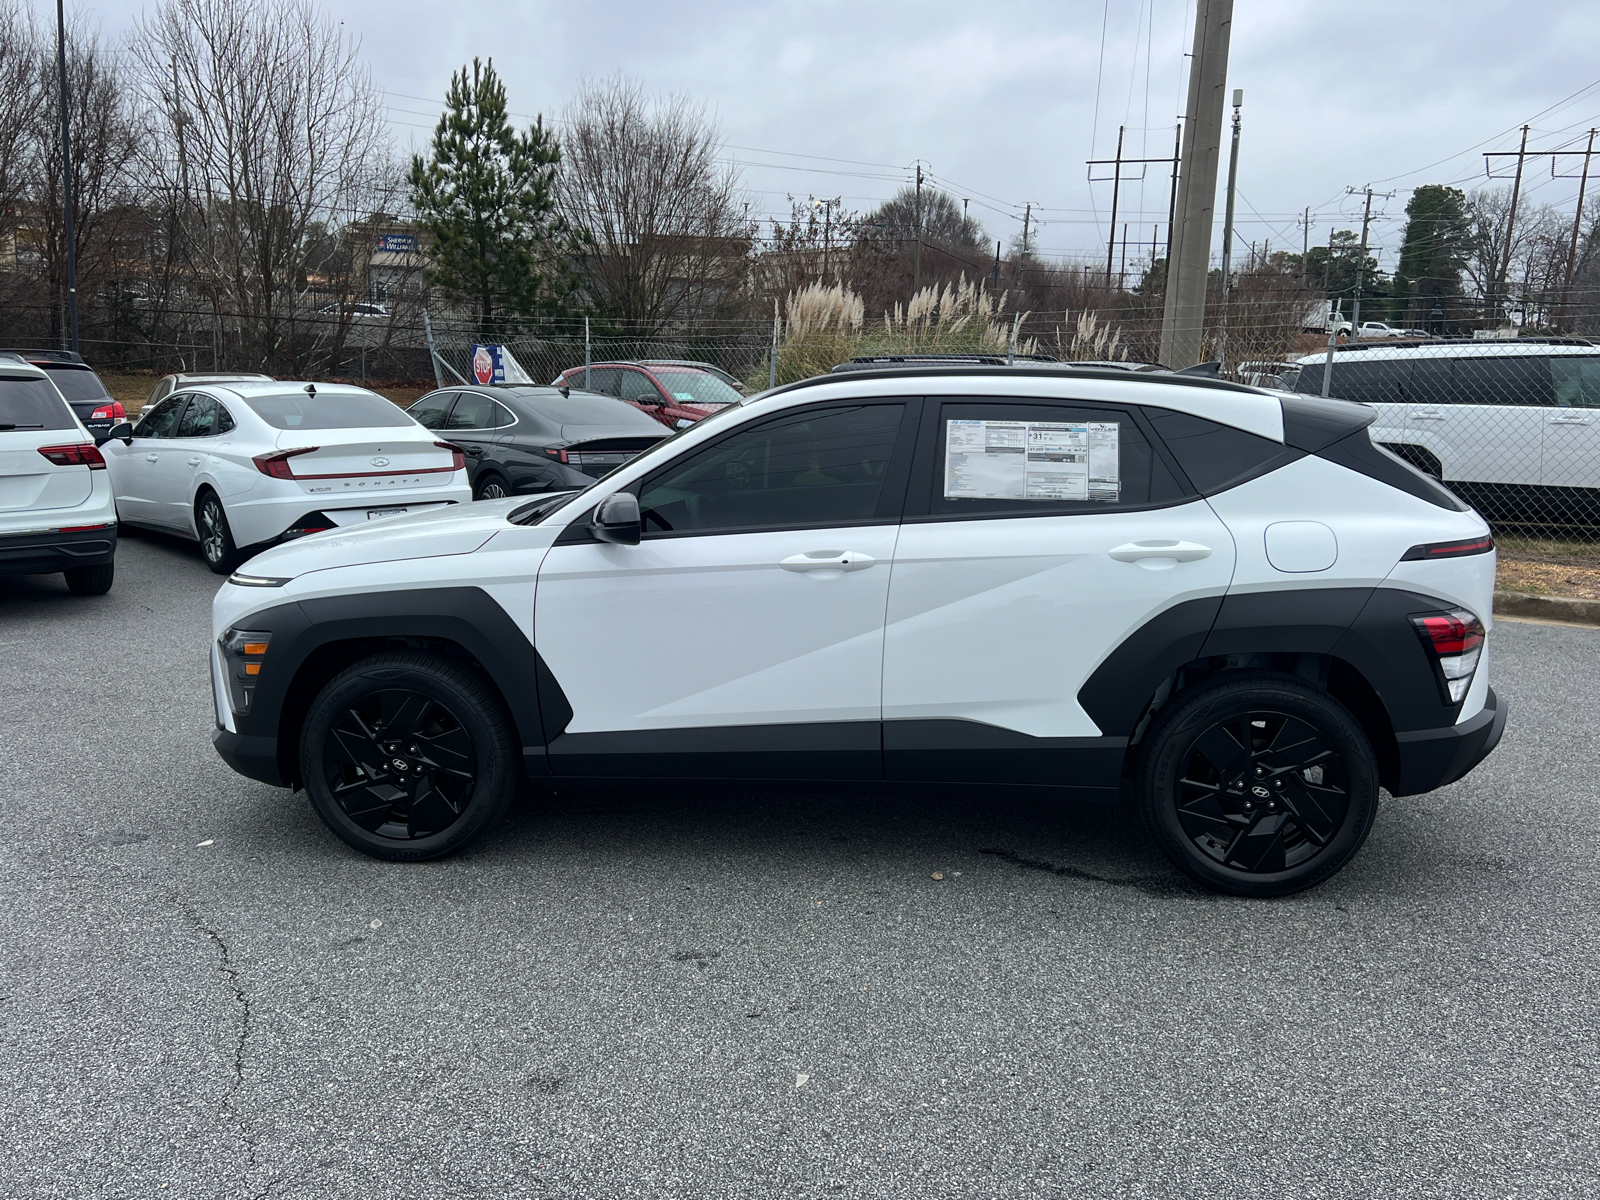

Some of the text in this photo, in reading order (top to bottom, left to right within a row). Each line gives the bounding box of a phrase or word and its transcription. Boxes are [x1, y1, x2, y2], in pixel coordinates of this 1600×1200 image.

[476, 360, 490, 373] STOP
[343, 478, 420, 487] SONATA
[312, 691, 343, 733] SOLUS
[1155, 760, 1169, 815] SOLUS
[1352, 777, 1370, 835] KUMHO
[446, 803, 488, 846] KUMHO
